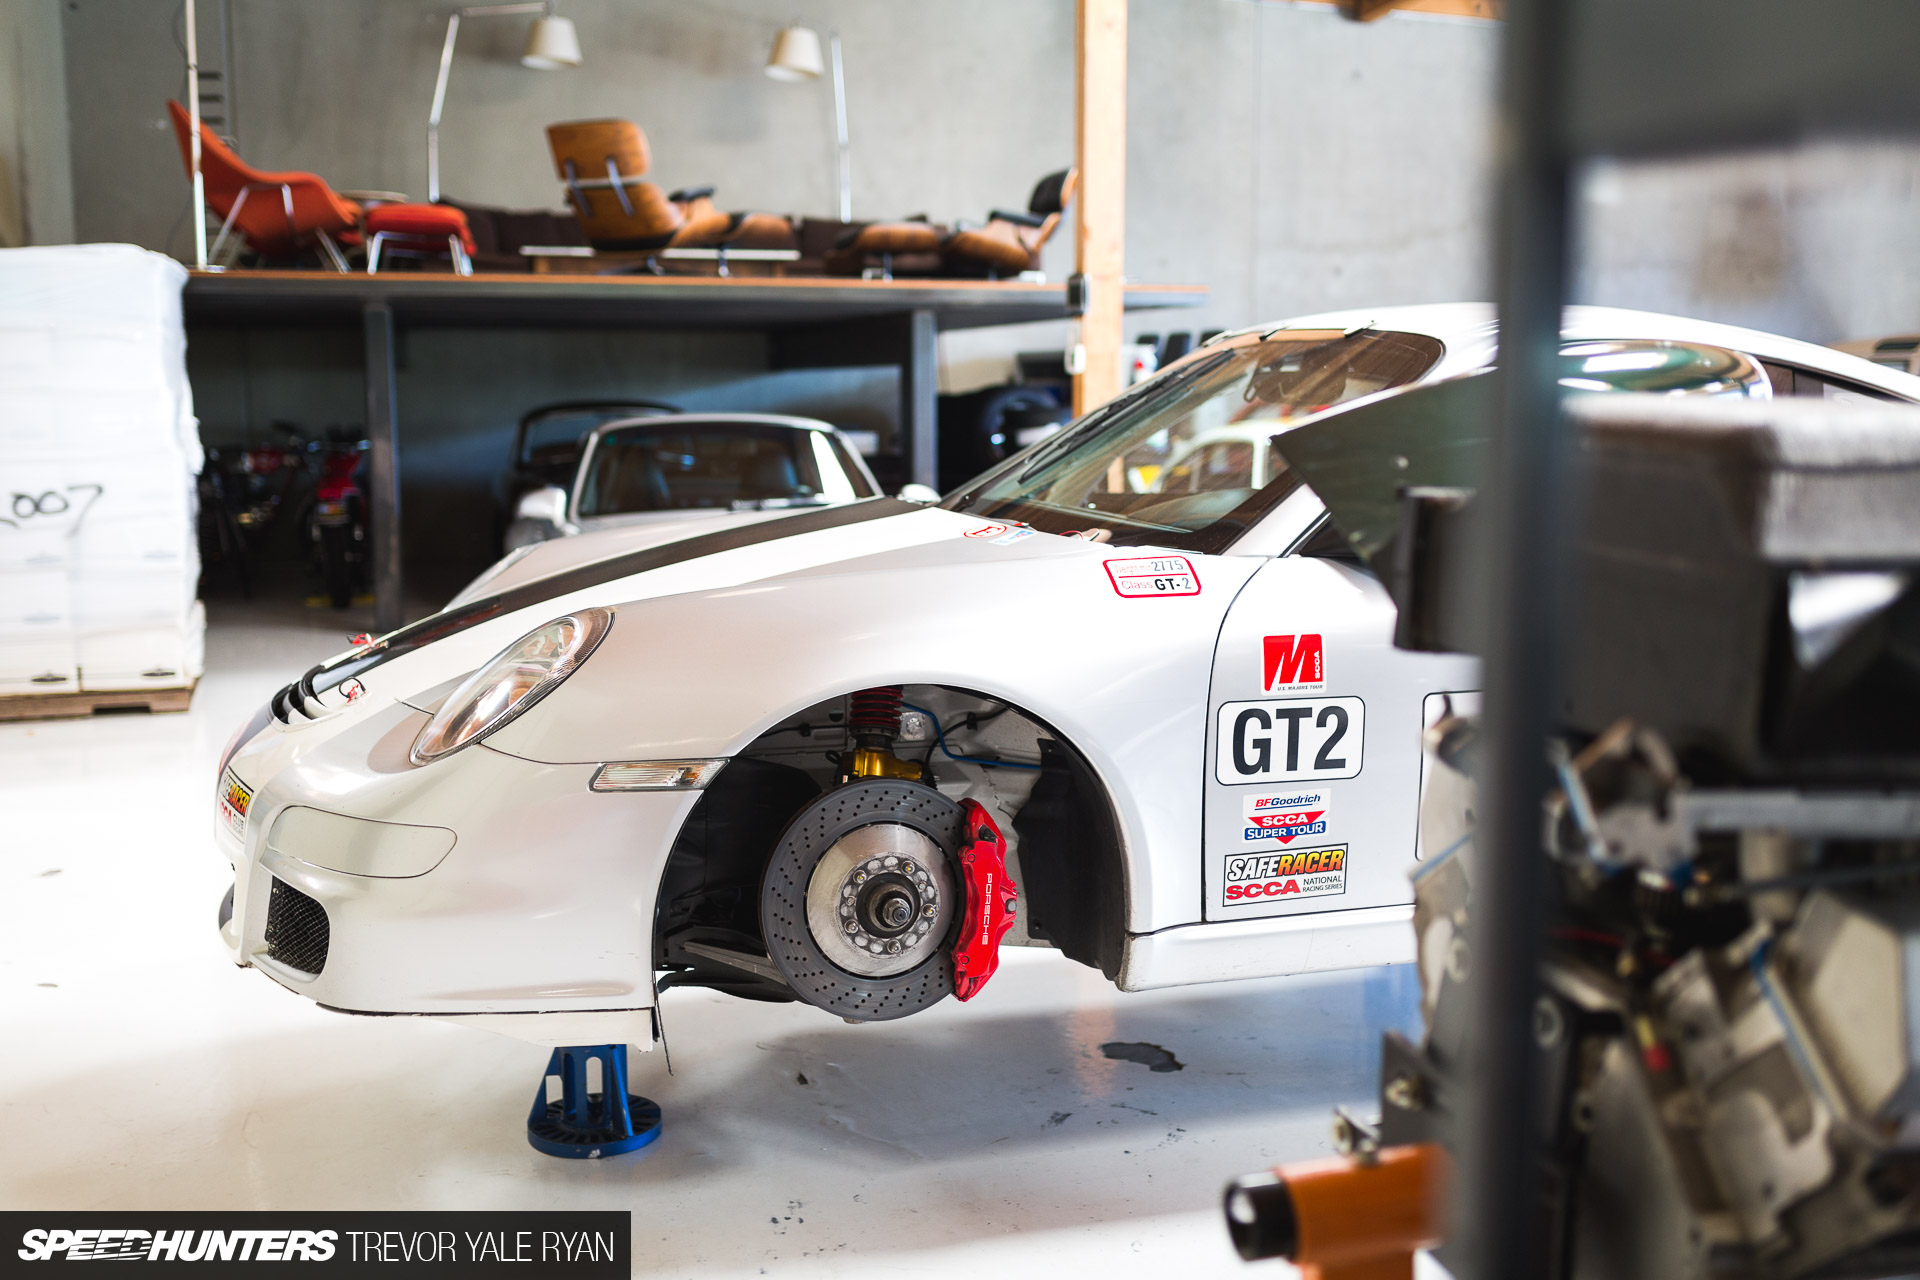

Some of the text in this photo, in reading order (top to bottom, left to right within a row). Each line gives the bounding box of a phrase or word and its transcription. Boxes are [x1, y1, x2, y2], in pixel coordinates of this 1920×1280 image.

[1151, 560, 1184, 572] 2775
[1121, 580, 1153, 590] Class
[1232, 705, 1349, 775] GT2
[1255, 794, 1321, 808] BFGoodrich
[1261, 813, 1309, 826] SCCA
[1247, 822, 1324, 839] SUPER TOUR
[1227, 849, 1345, 881] SAFERACER
[1302, 882, 1343, 893] RACING SERIES
[1303, 875, 1342, 886] NATIONAL
[1226, 879, 1301, 900] SCCA
[981, 873, 993, 945] PORSCHE
